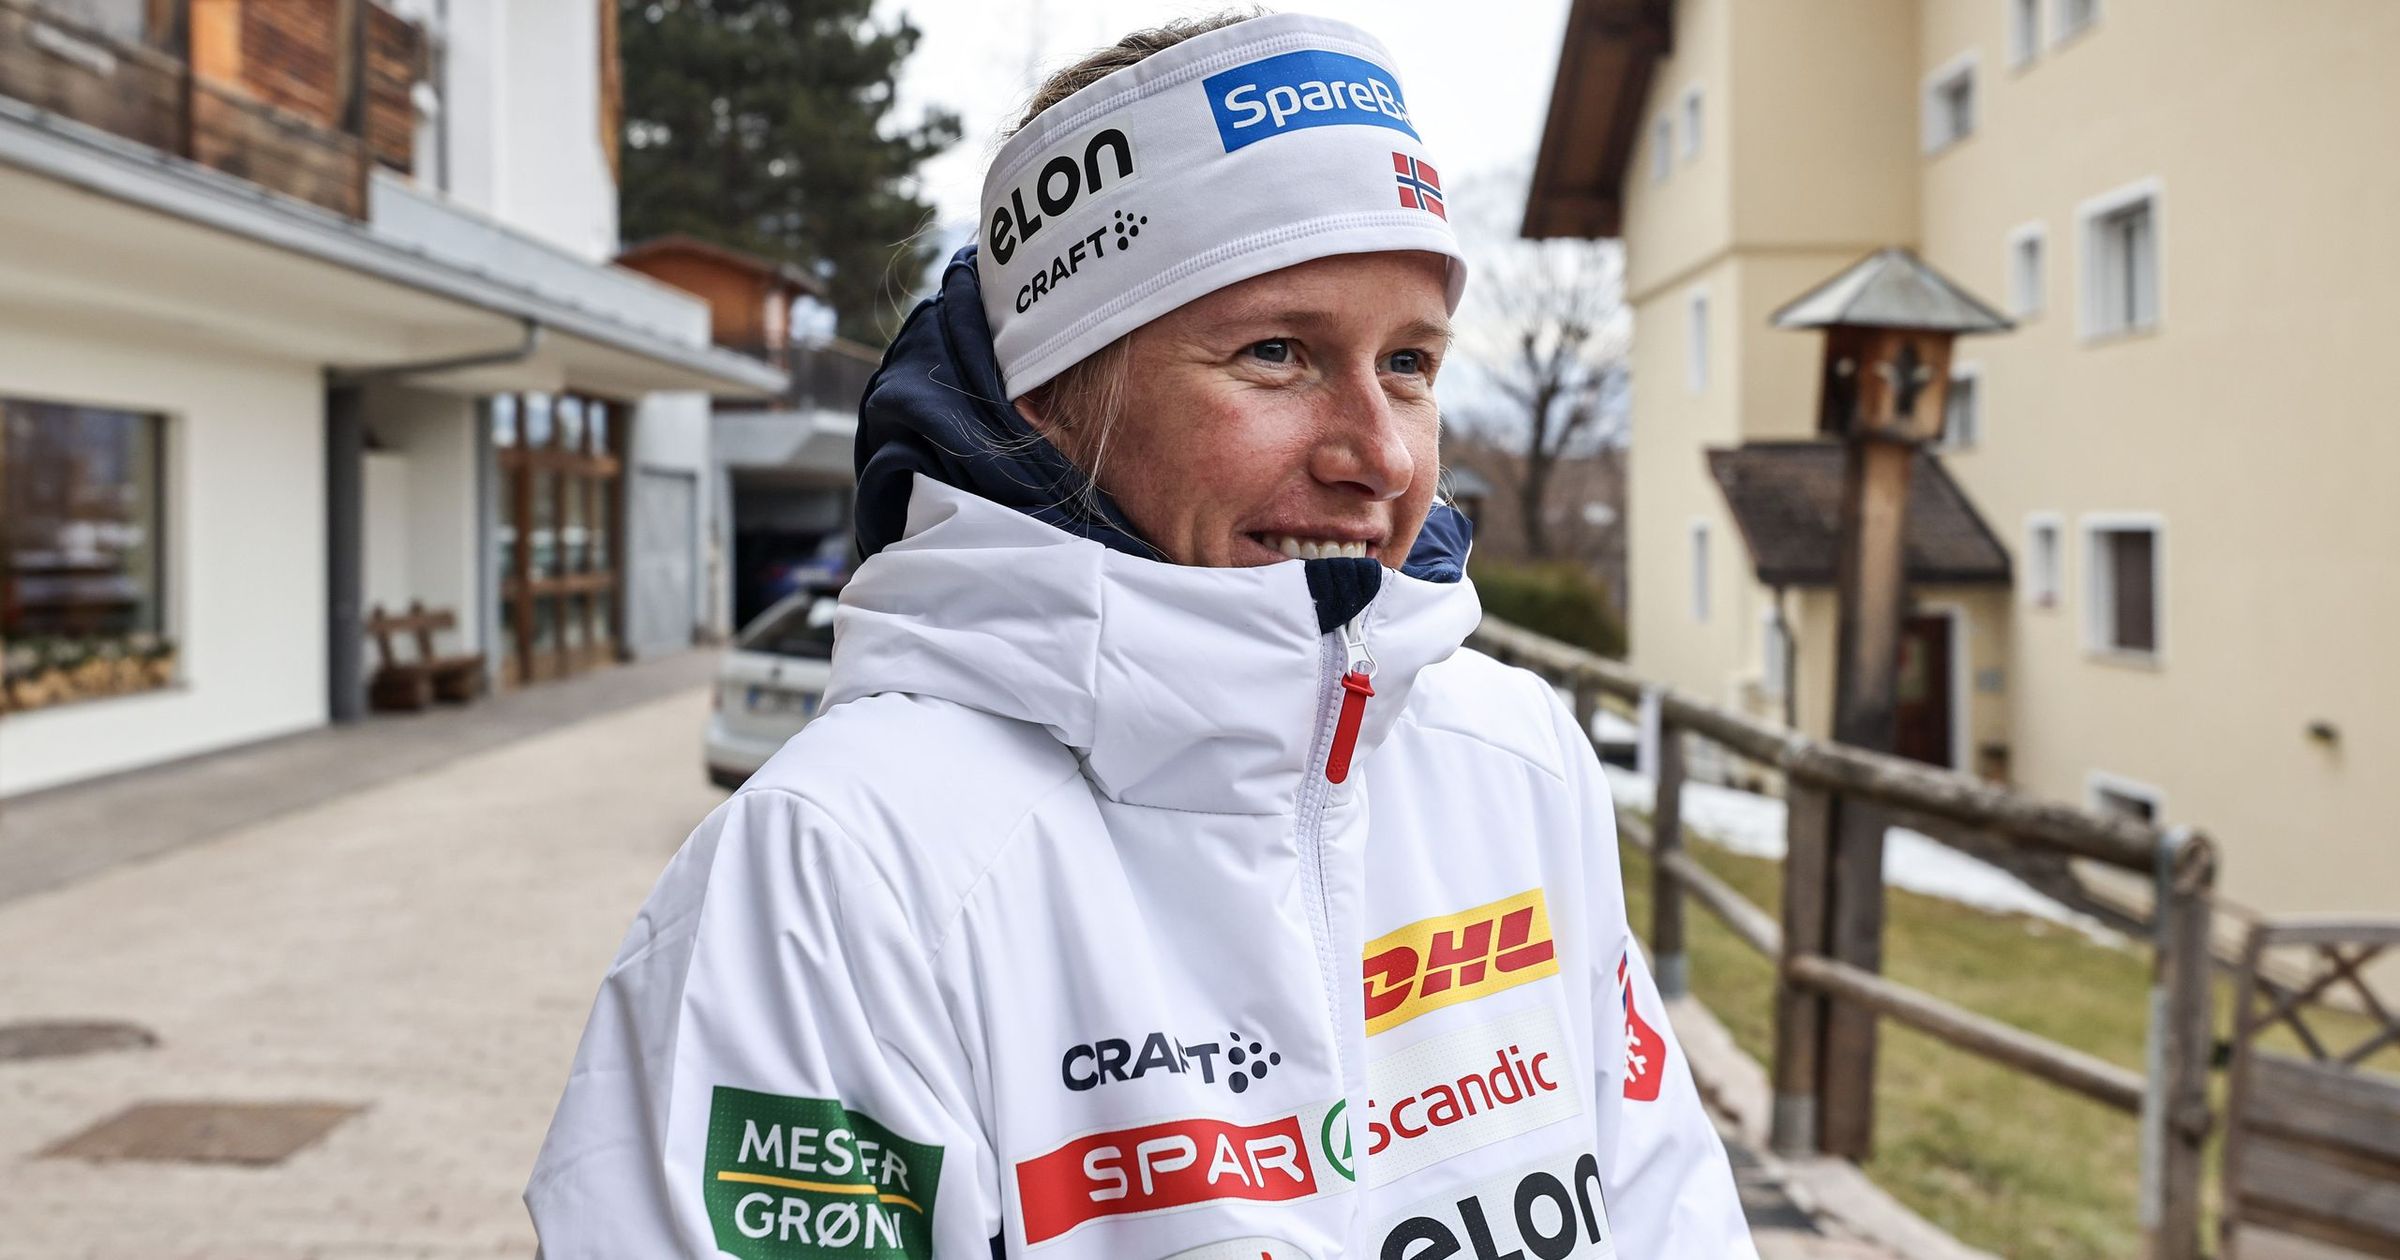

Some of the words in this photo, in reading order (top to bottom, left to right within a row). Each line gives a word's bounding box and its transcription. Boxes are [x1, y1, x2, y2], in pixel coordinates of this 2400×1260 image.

[1016, 226, 1107, 314] CRAFT
[1363, 906, 1553, 1020] DHL
[737, 1119, 910, 1191] MESER
[1083, 1133, 1304, 1201] SPAR
